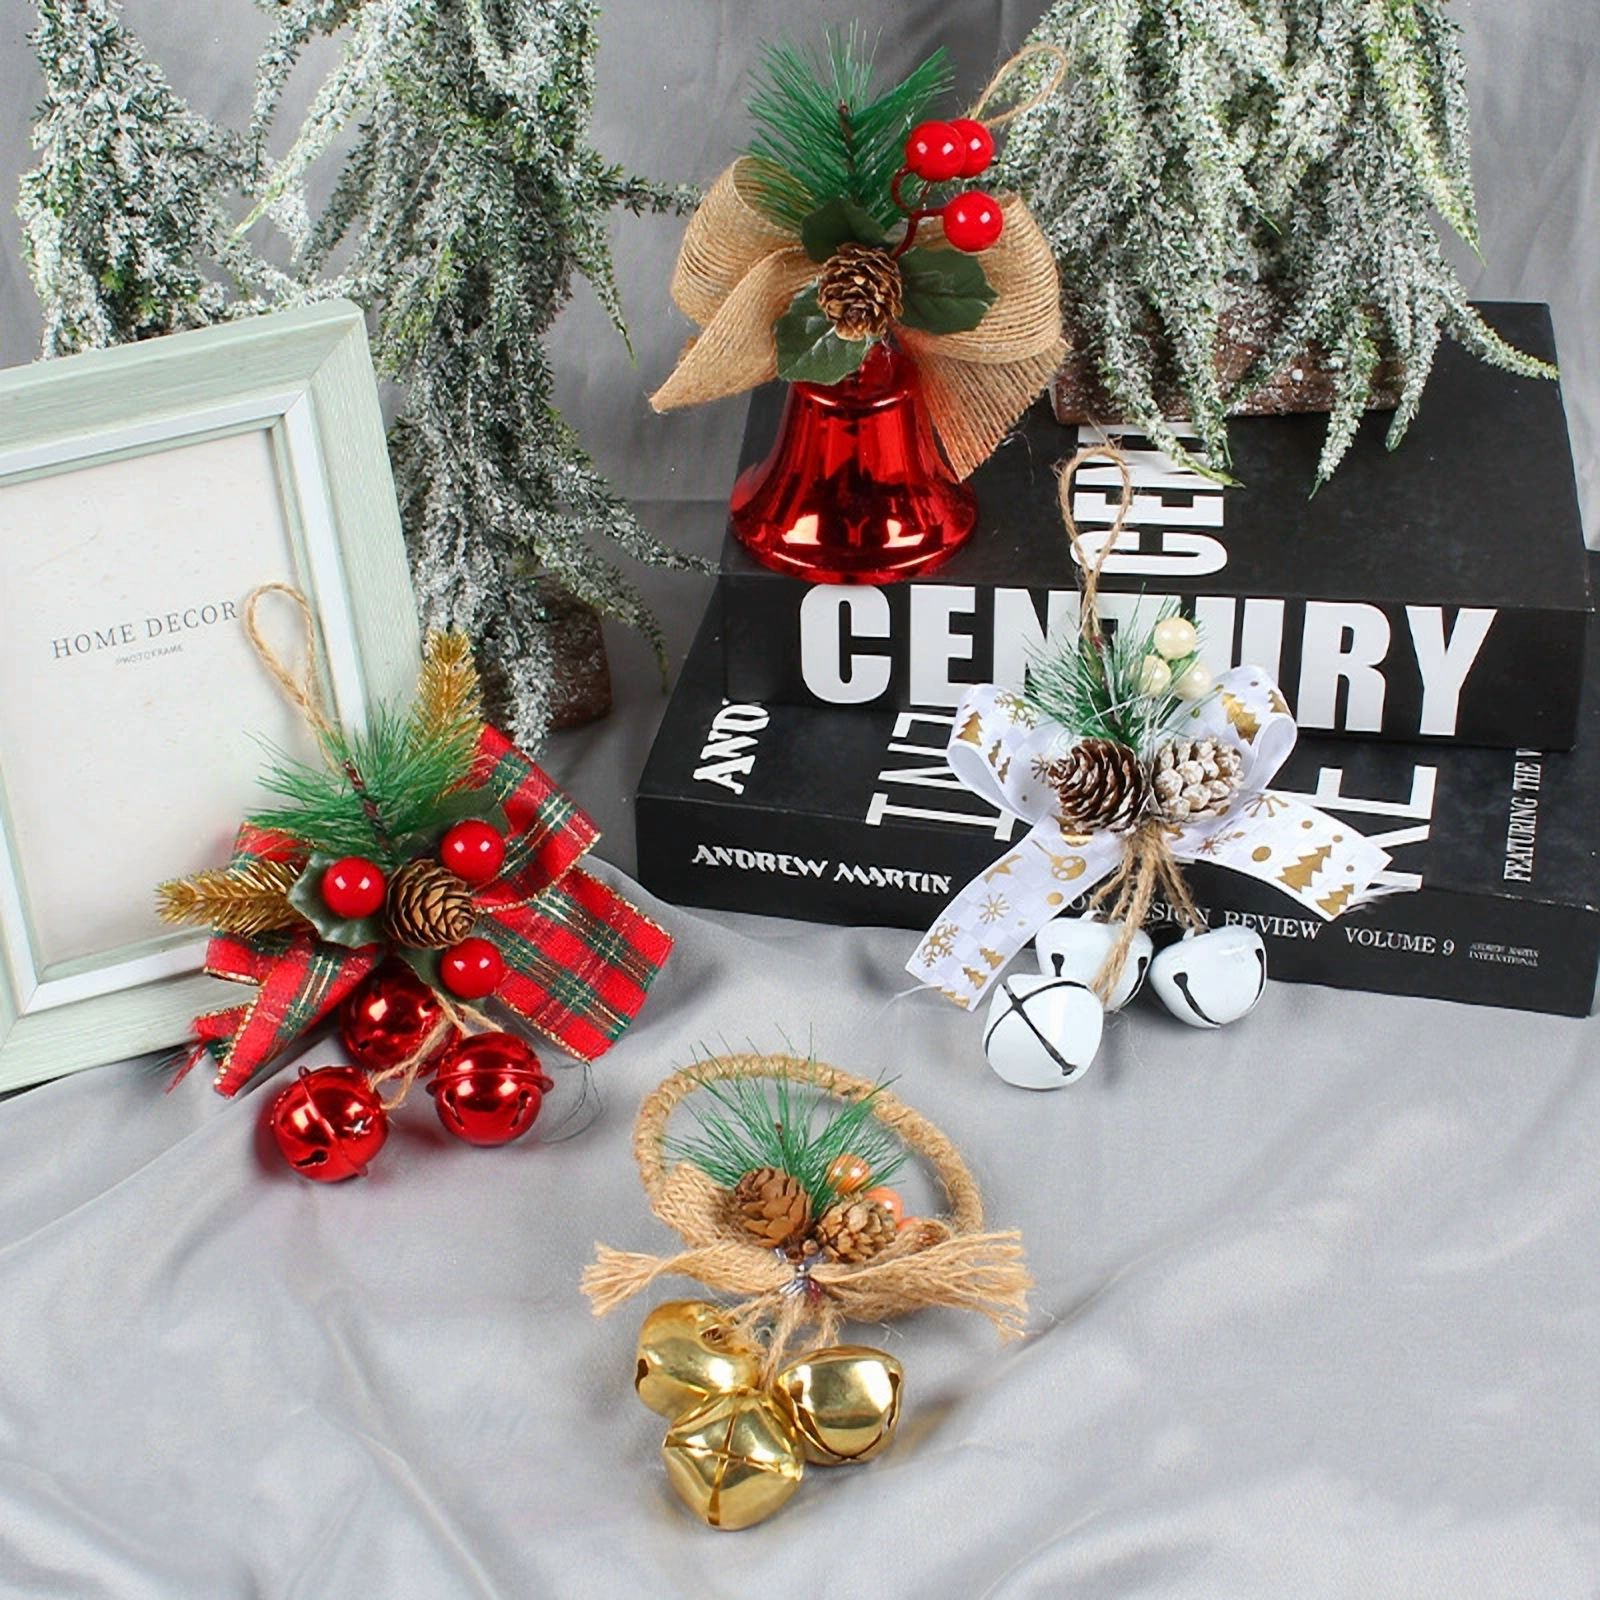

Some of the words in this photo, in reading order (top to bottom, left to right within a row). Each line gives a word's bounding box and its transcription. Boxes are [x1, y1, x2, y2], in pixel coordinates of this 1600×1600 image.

[52, 623, 136, 659] HOME
[146, 600, 238, 639] DECOR
[1512, 761, 1542, 791] THE
[1503, 796, 1539, 882] FEATURING
[691, 844, 828, 878] ANDREW
[833, 861, 952, 895] MARTIN
[1224, 910, 1322, 940] REVIEW
[1344, 926, 1436, 954] VOLUME
[1442, 938, 1455, 957] 9
